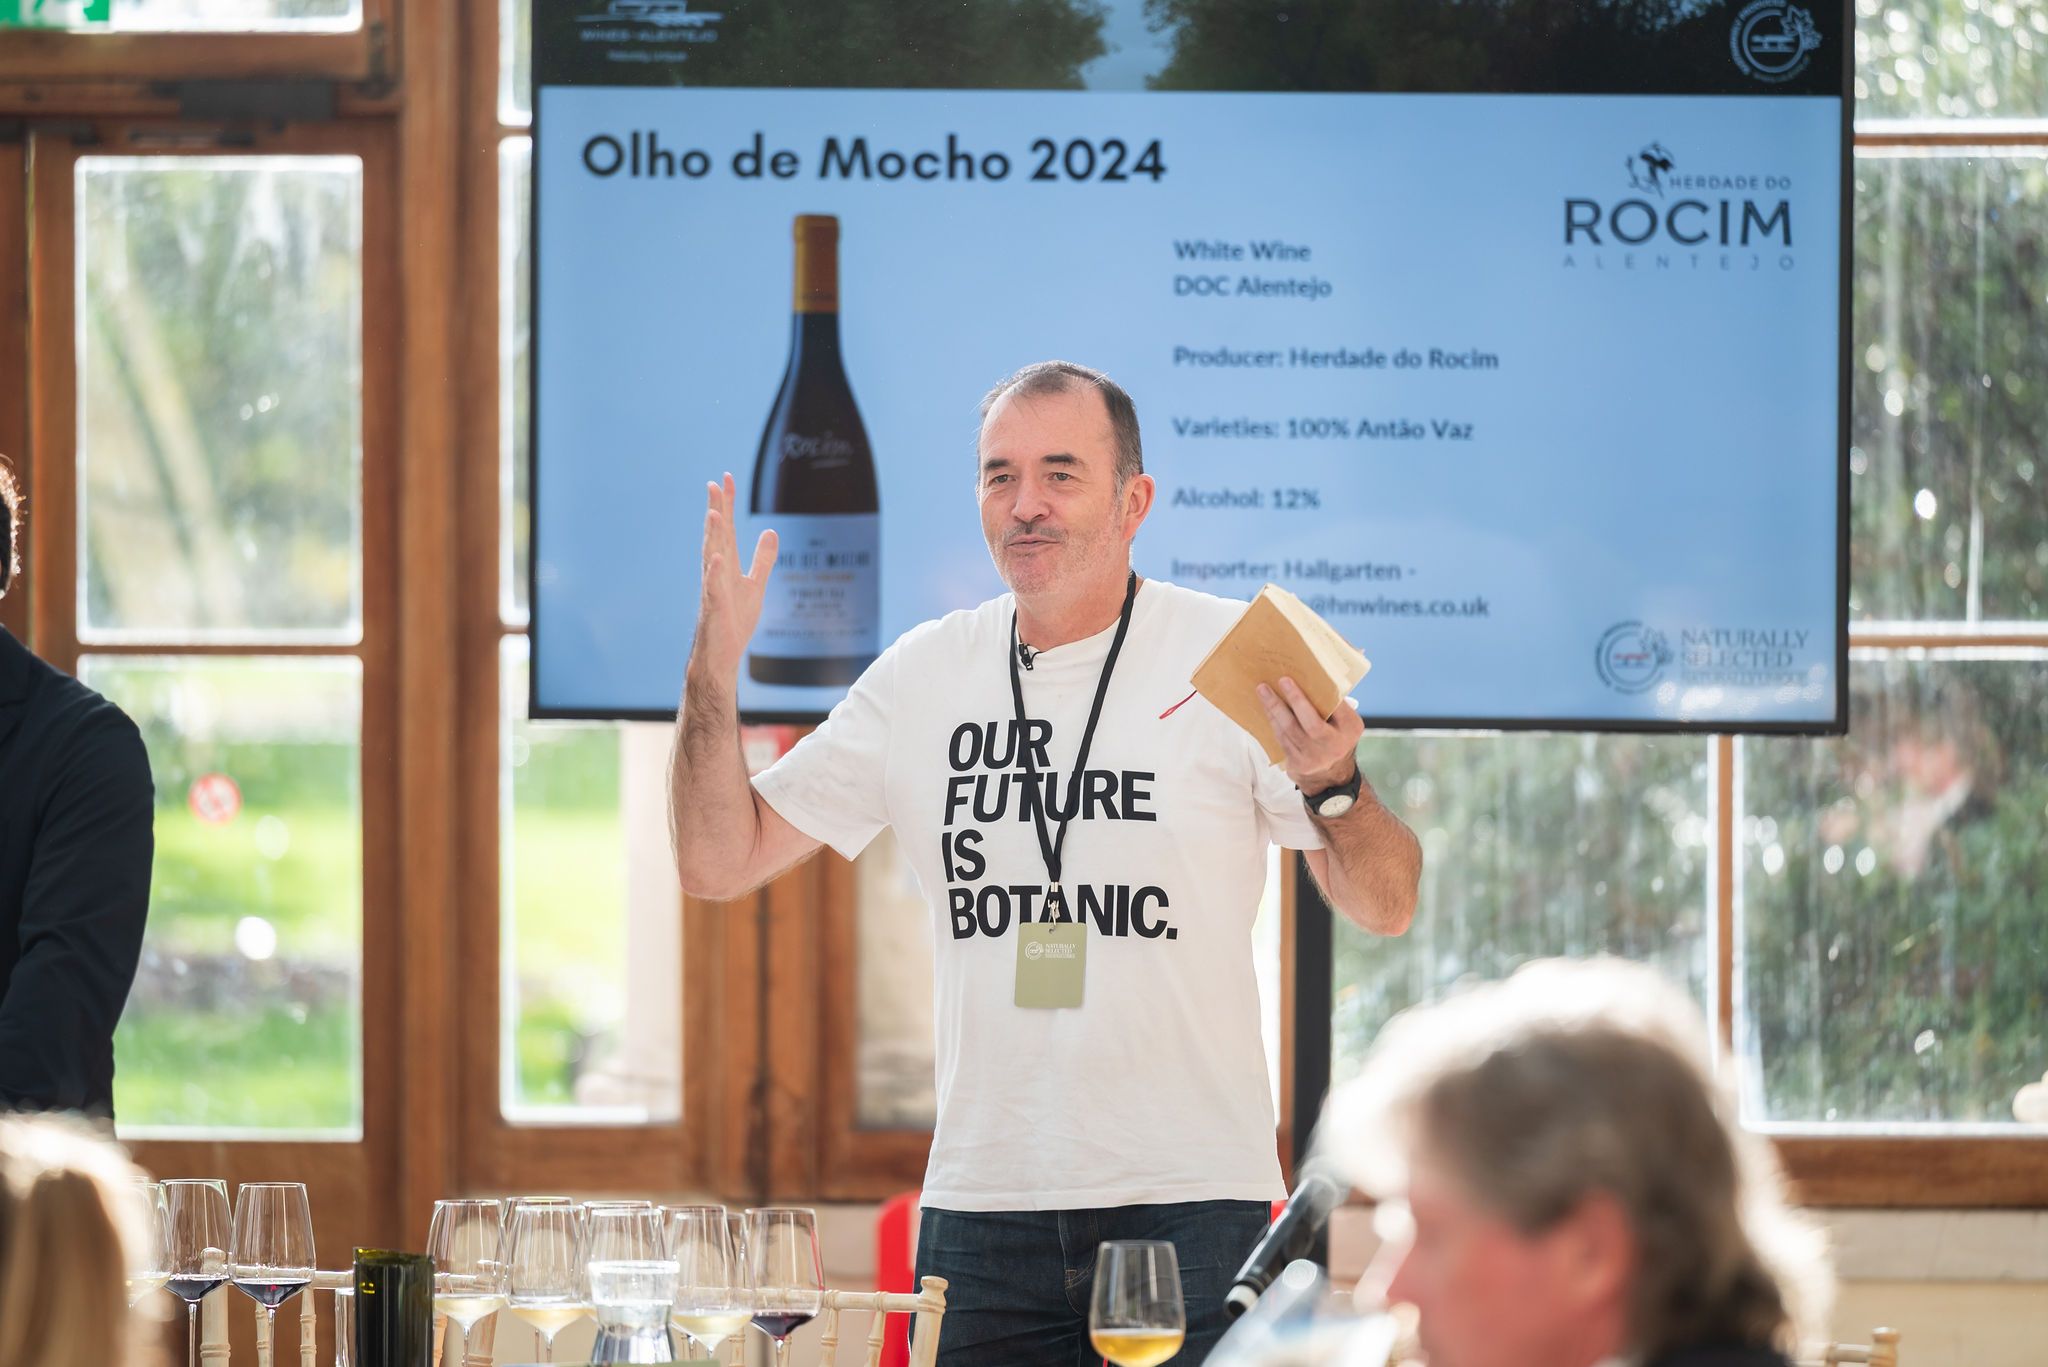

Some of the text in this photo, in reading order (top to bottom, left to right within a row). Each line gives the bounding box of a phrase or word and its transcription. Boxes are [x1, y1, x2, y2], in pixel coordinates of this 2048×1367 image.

[582, 131, 1167, 183] Olho de Mocho 2024
[1670, 177, 1791, 190] HERDADE DO
[1564, 199, 1792, 246] ROCIM
[1174, 241, 1312, 261] White Wine
[1562, 254, 1795, 271] ALENTEJO
[1174, 276, 1333, 300] DOC Alentejo
[1174, 347, 1499, 370] Producer: Herdade do Rocim
[1173, 418, 1474, 441] Varieties: 100% Antão Vaz
[1173, 488, 1320, 509] Alcohol: 12%
[1172, 559, 1279, 582] Importer:
[1284, 560, 1401, 584] Hallgarten
[948, 719, 1053, 771] OUR
[944, 769, 1157, 825] FUTURE
[942, 829, 986, 882] IS
[948, 884, 1178, 940] BOTANIC.
